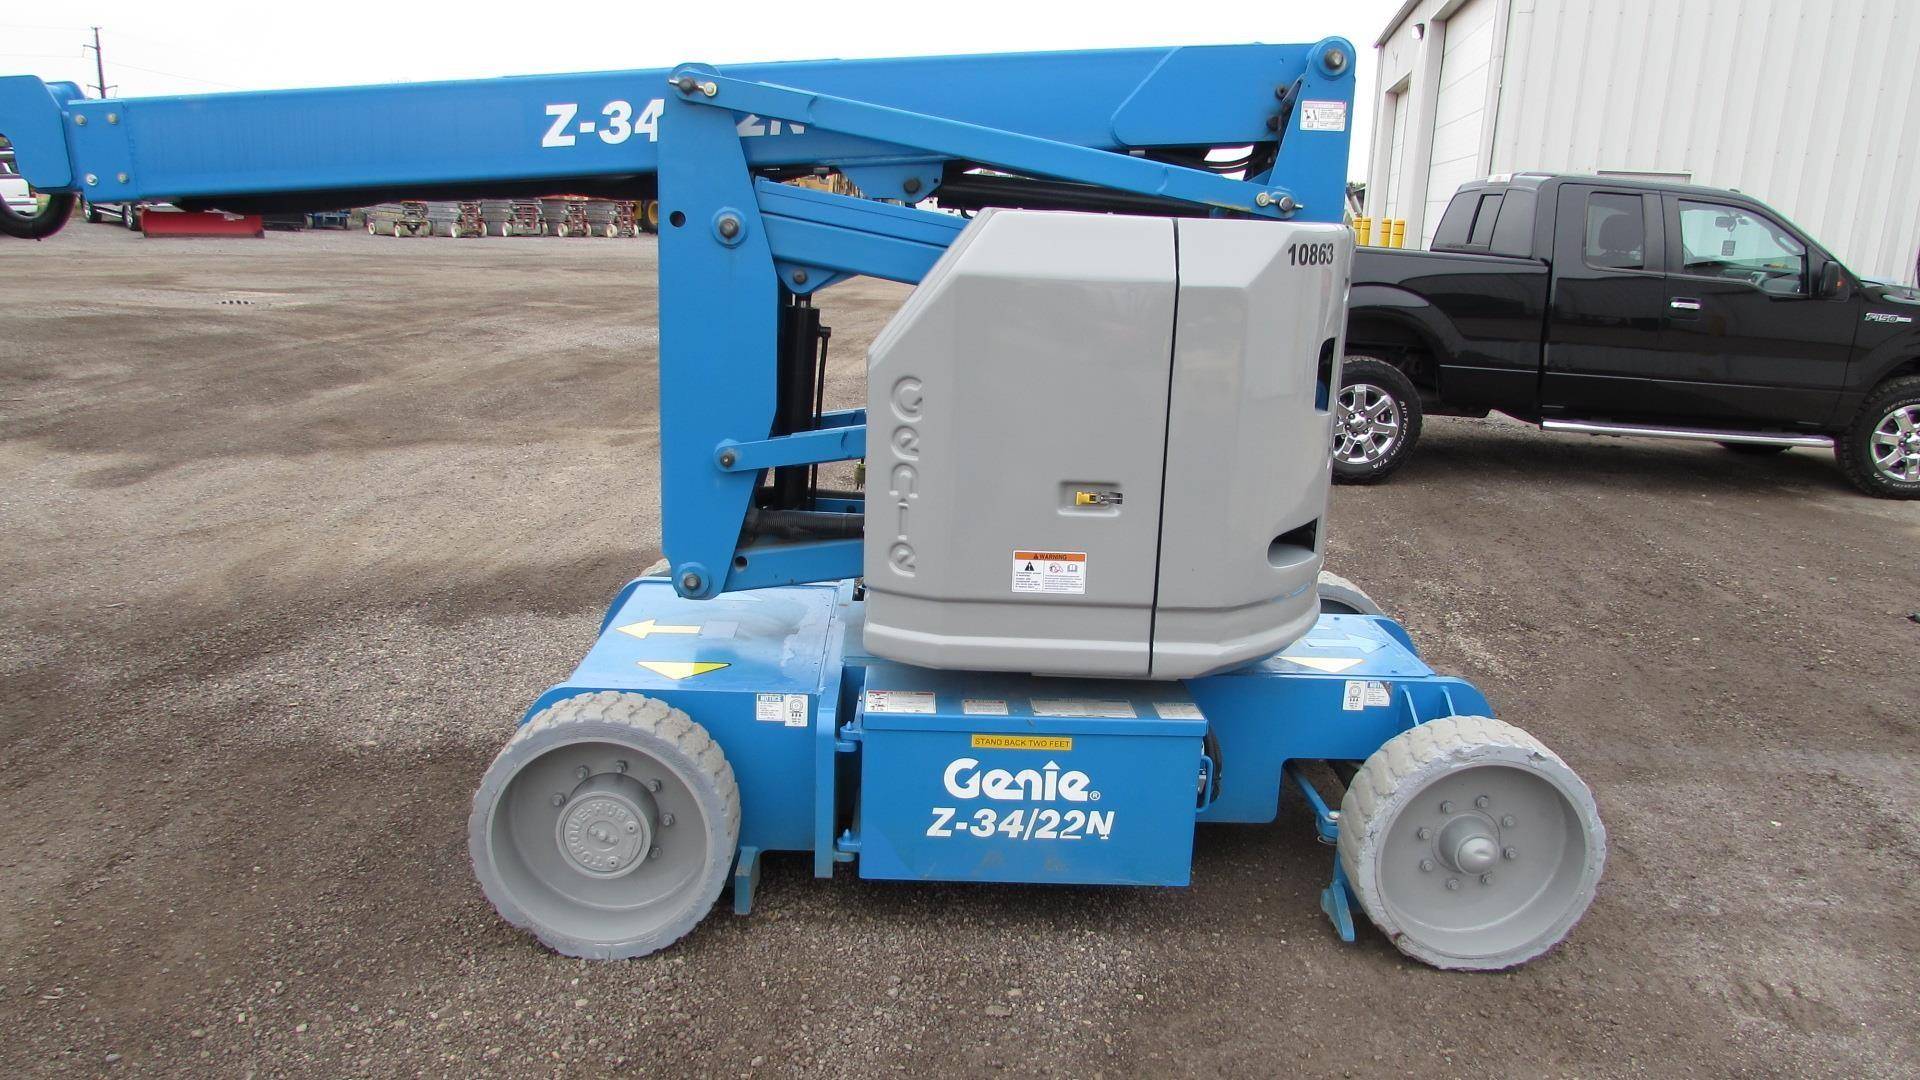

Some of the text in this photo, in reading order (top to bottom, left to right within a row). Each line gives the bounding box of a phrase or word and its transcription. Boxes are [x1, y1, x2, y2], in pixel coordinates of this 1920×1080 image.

[1287, 243, 1334, 266] 10863
[889, 374, 923, 578] Genie
[1039, 553, 1067, 561] WARNING
[975, 737, 1070, 748] STAND BACK TWO FEET
[926, 807, 1115, 841] Z-34/22N
